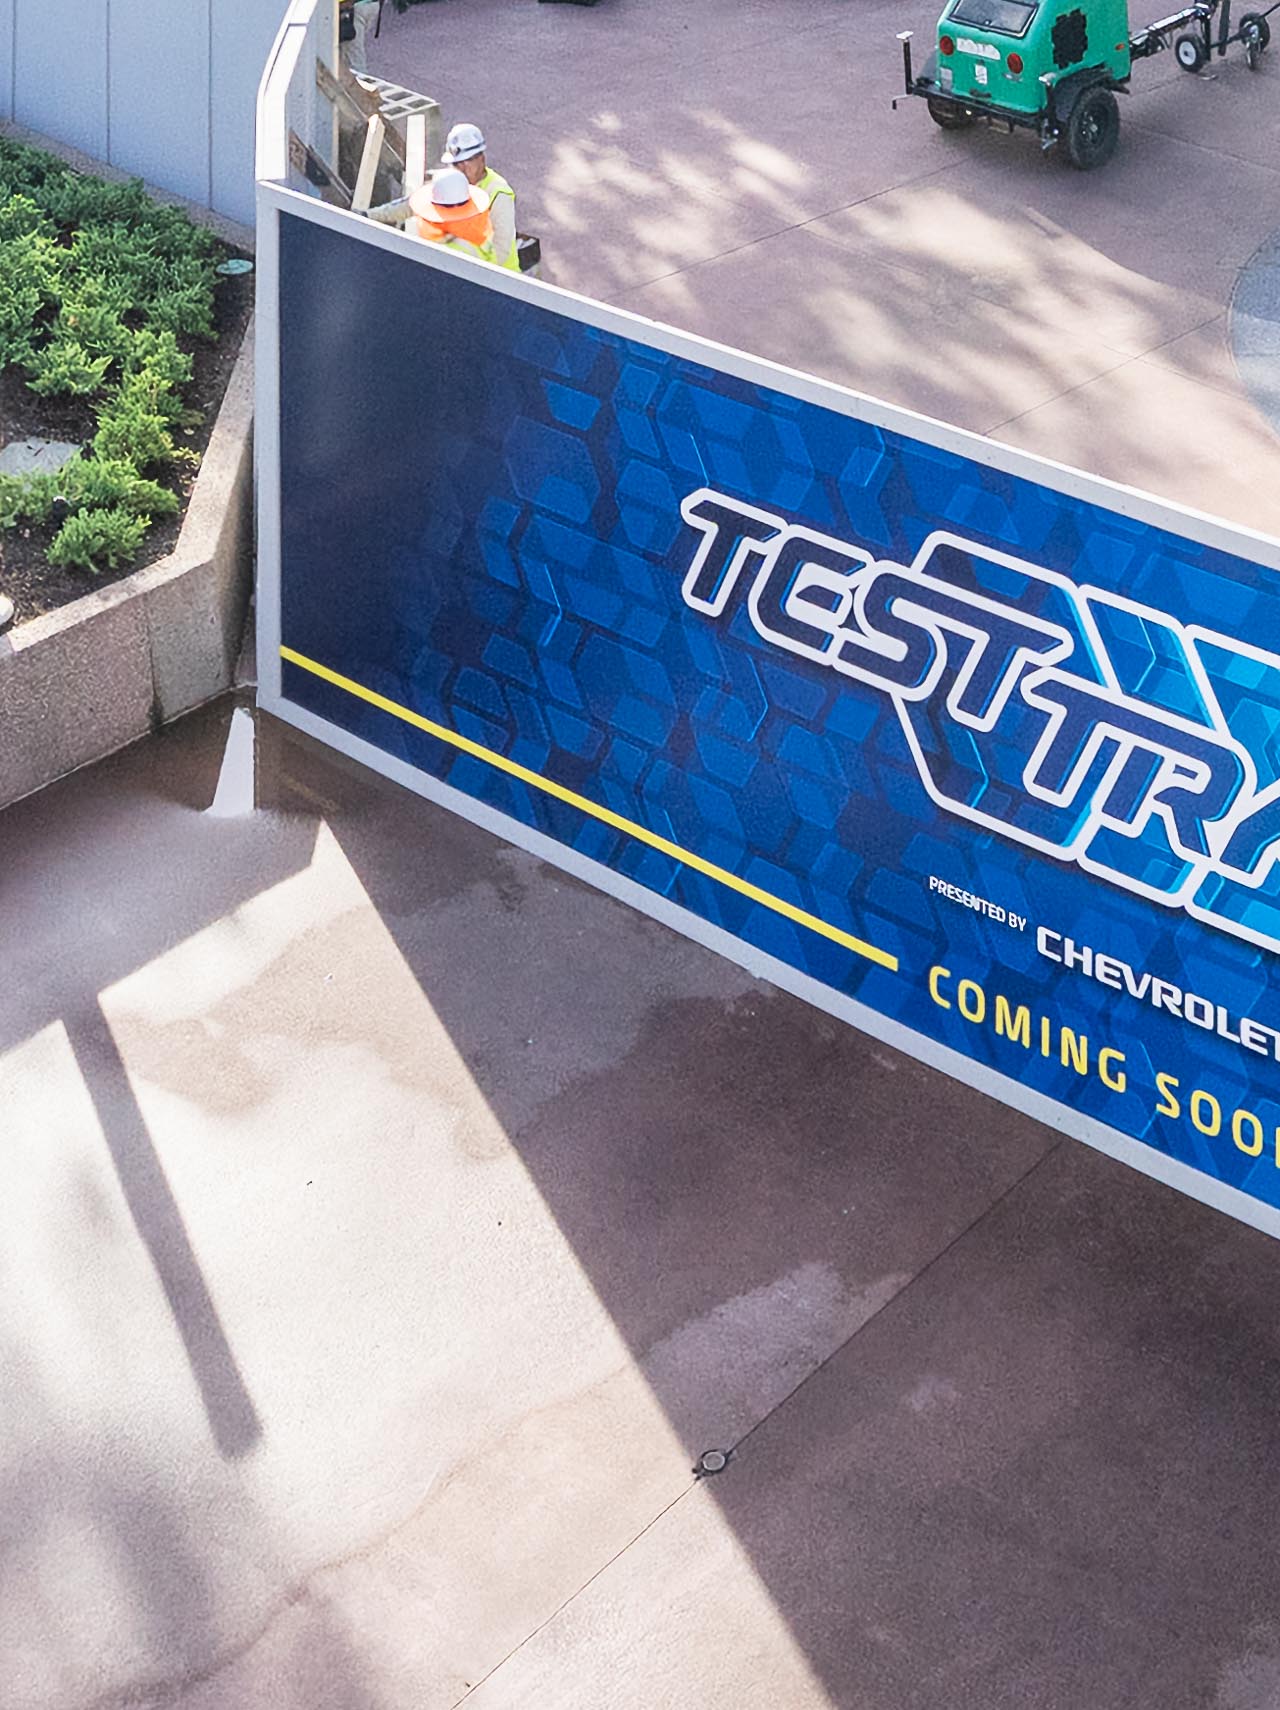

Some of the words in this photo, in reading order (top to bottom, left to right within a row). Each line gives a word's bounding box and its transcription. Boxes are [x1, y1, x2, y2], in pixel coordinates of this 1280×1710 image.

[680, 487, 1075, 732] TEST
[929, 876, 1006, 924] PRESENTED
[1008, 911, 1027, 932] BY
[928, 965, 1127, 1094] COMING
